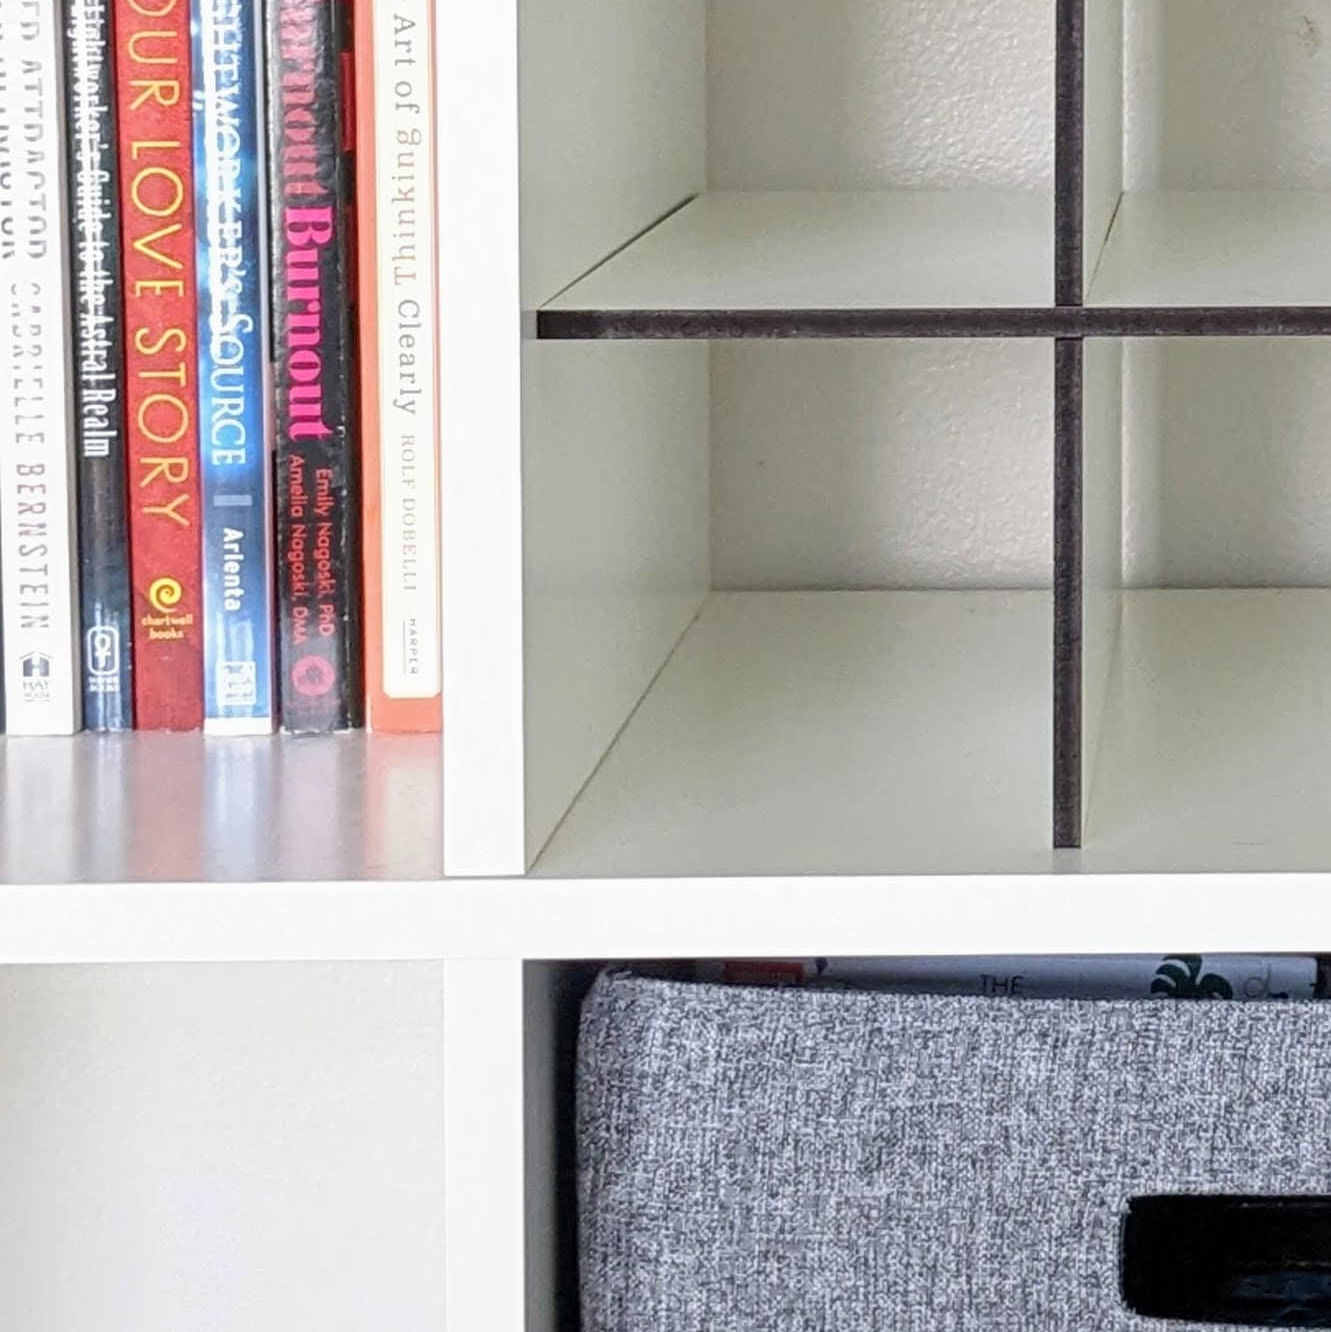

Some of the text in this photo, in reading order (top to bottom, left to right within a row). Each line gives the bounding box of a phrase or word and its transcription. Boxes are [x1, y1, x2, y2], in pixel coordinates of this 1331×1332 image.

[68, 4, 109, 162] Lightworker's
[393, 13, 418, 67] Art
[394, 80, 421, 115] of
[131, 140, 186, 297] LOVE
[392, 128, 423, 287] Thinking
[80, 268, 115, 306] the
[283, 205, 336, 442] Burnout
[80, 312, 116, 381] Astral
[209, 312, 254, 466] SOURCE
[393, 299, 422, 416] Clearly
[82, 387, 119, 458] Realm
[134, 327, 191, 527] STORY
[401, 434, 417, 490] ROLF
[16, 464, 50, 629] BERNSTEIN
[223, 527, 245, 611] Arienta
[289, 454, 308, 645] Amelia Nagoski, DMA
[316, 468, 338, 637] Emily Nagoski, PhD
[402, 498, 419, 592] DOBELLI
[149, 628, 184, 640] books
